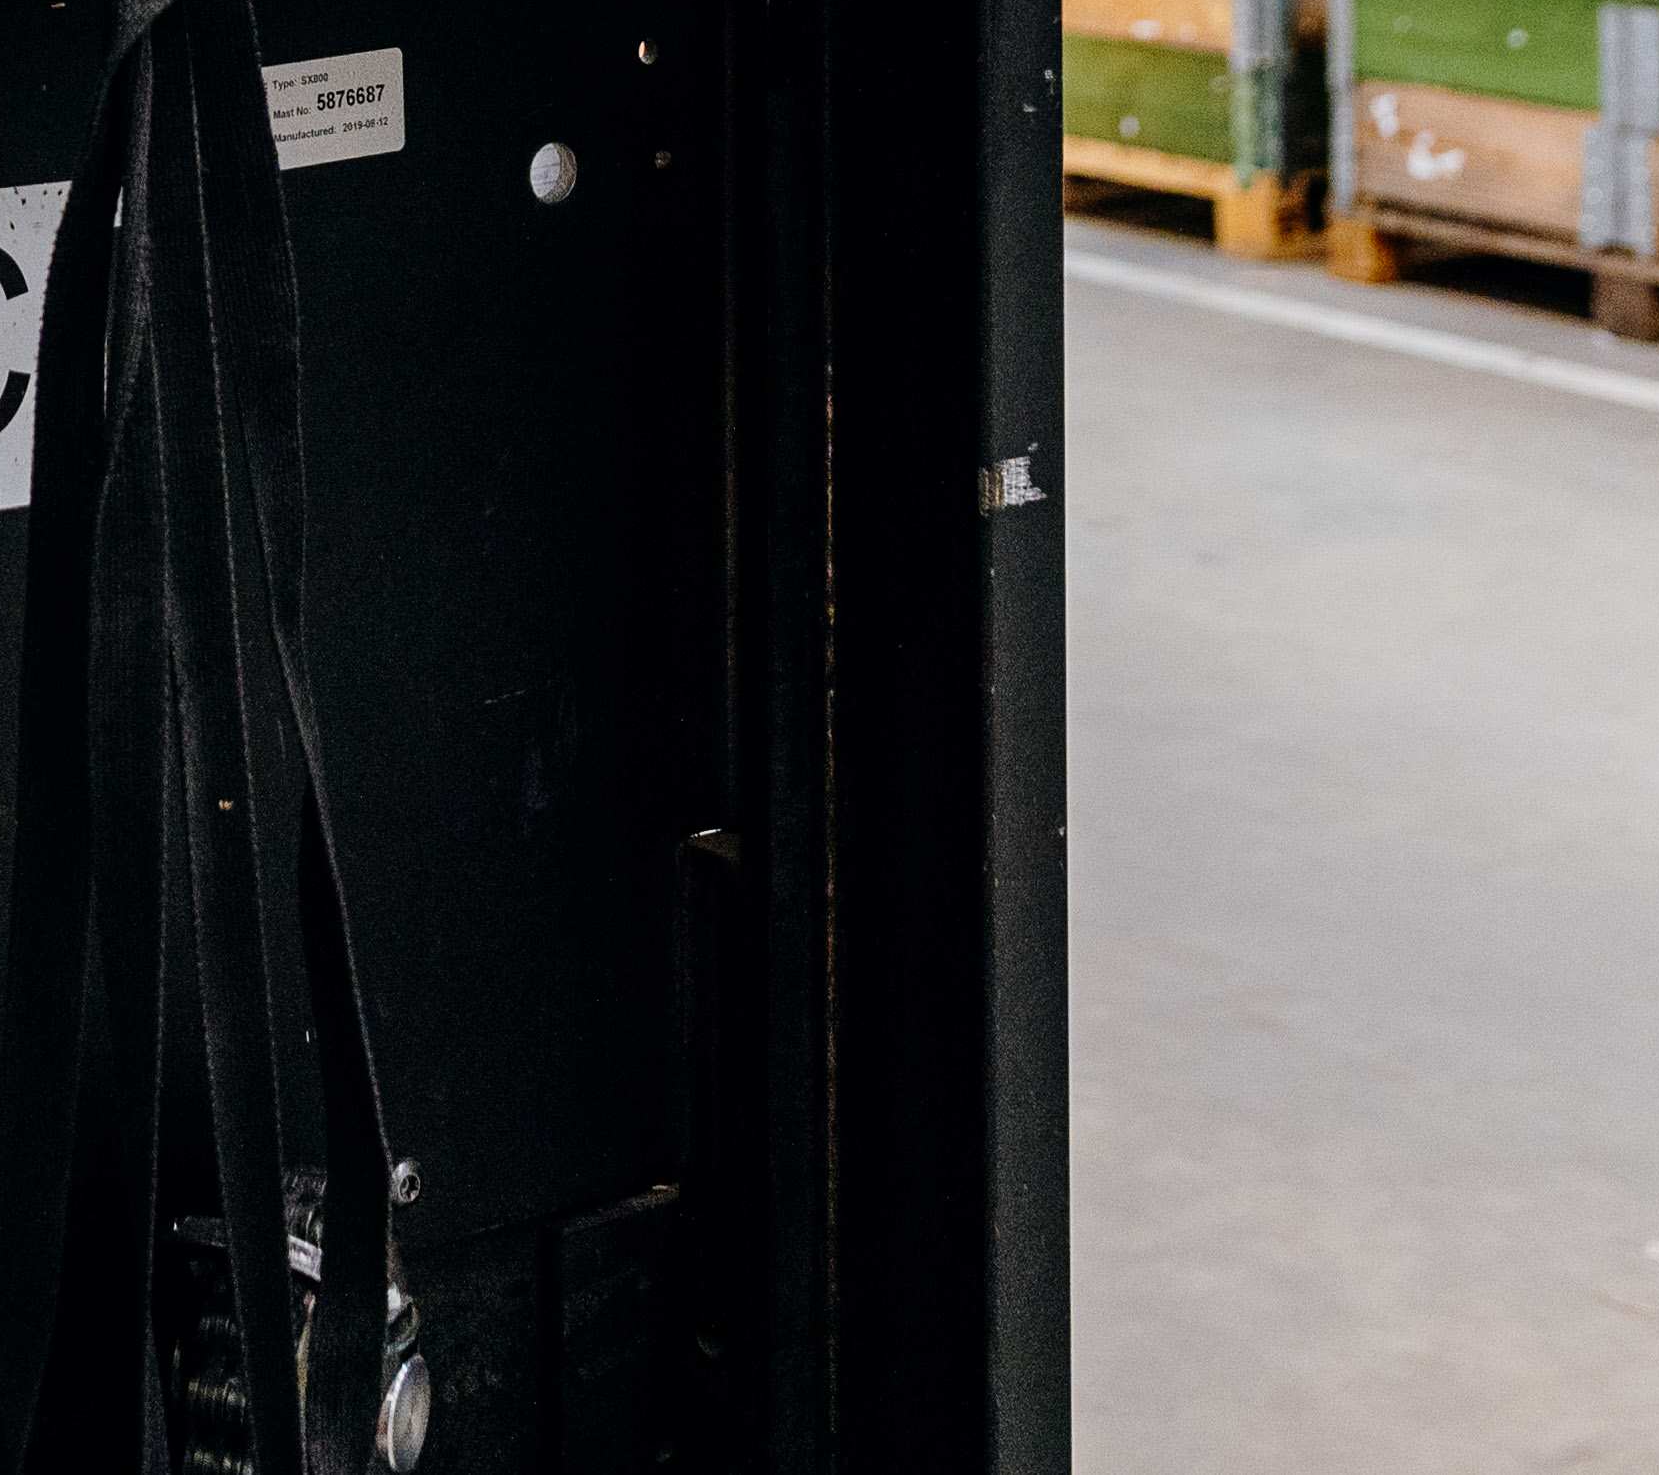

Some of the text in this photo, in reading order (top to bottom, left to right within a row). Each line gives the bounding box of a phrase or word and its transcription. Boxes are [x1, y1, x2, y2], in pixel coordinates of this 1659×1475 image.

[271, 79, 298, 92] Type:
[272, 83, 386, 120] Mast No: 5876687
